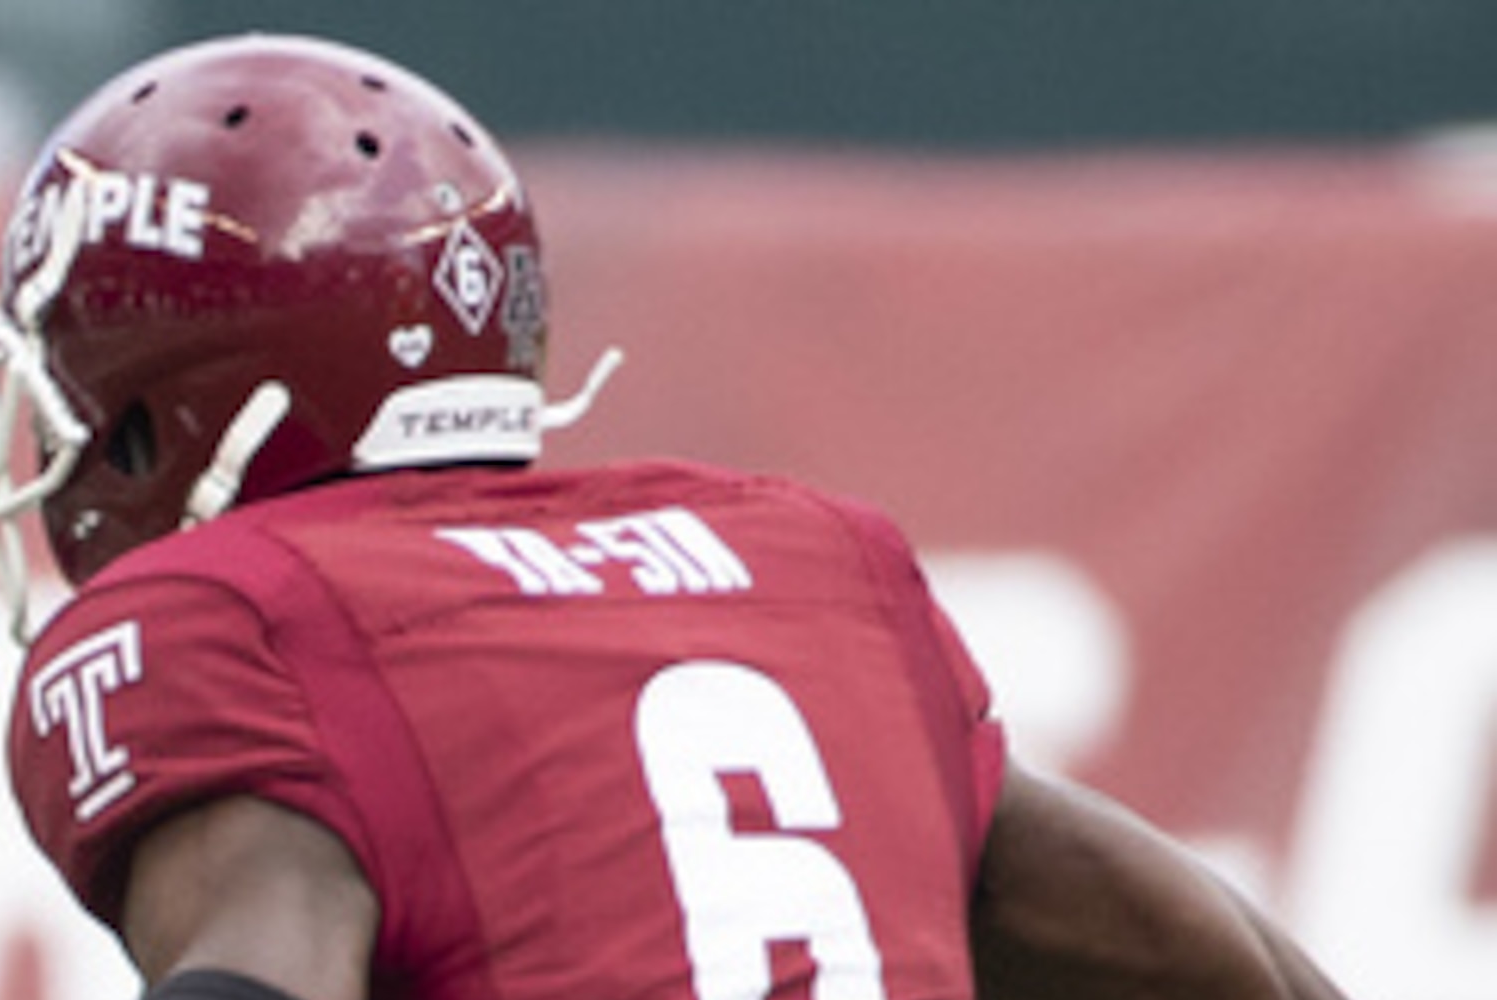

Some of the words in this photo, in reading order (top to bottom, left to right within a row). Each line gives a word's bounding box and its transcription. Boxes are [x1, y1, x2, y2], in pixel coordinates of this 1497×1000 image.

[456, 246, 488, 304] 6
[399, 406, 533, 437] TEMPLE
[434, 505, 753, 594] YA-SIN
[30, 619, 141, 822] T
